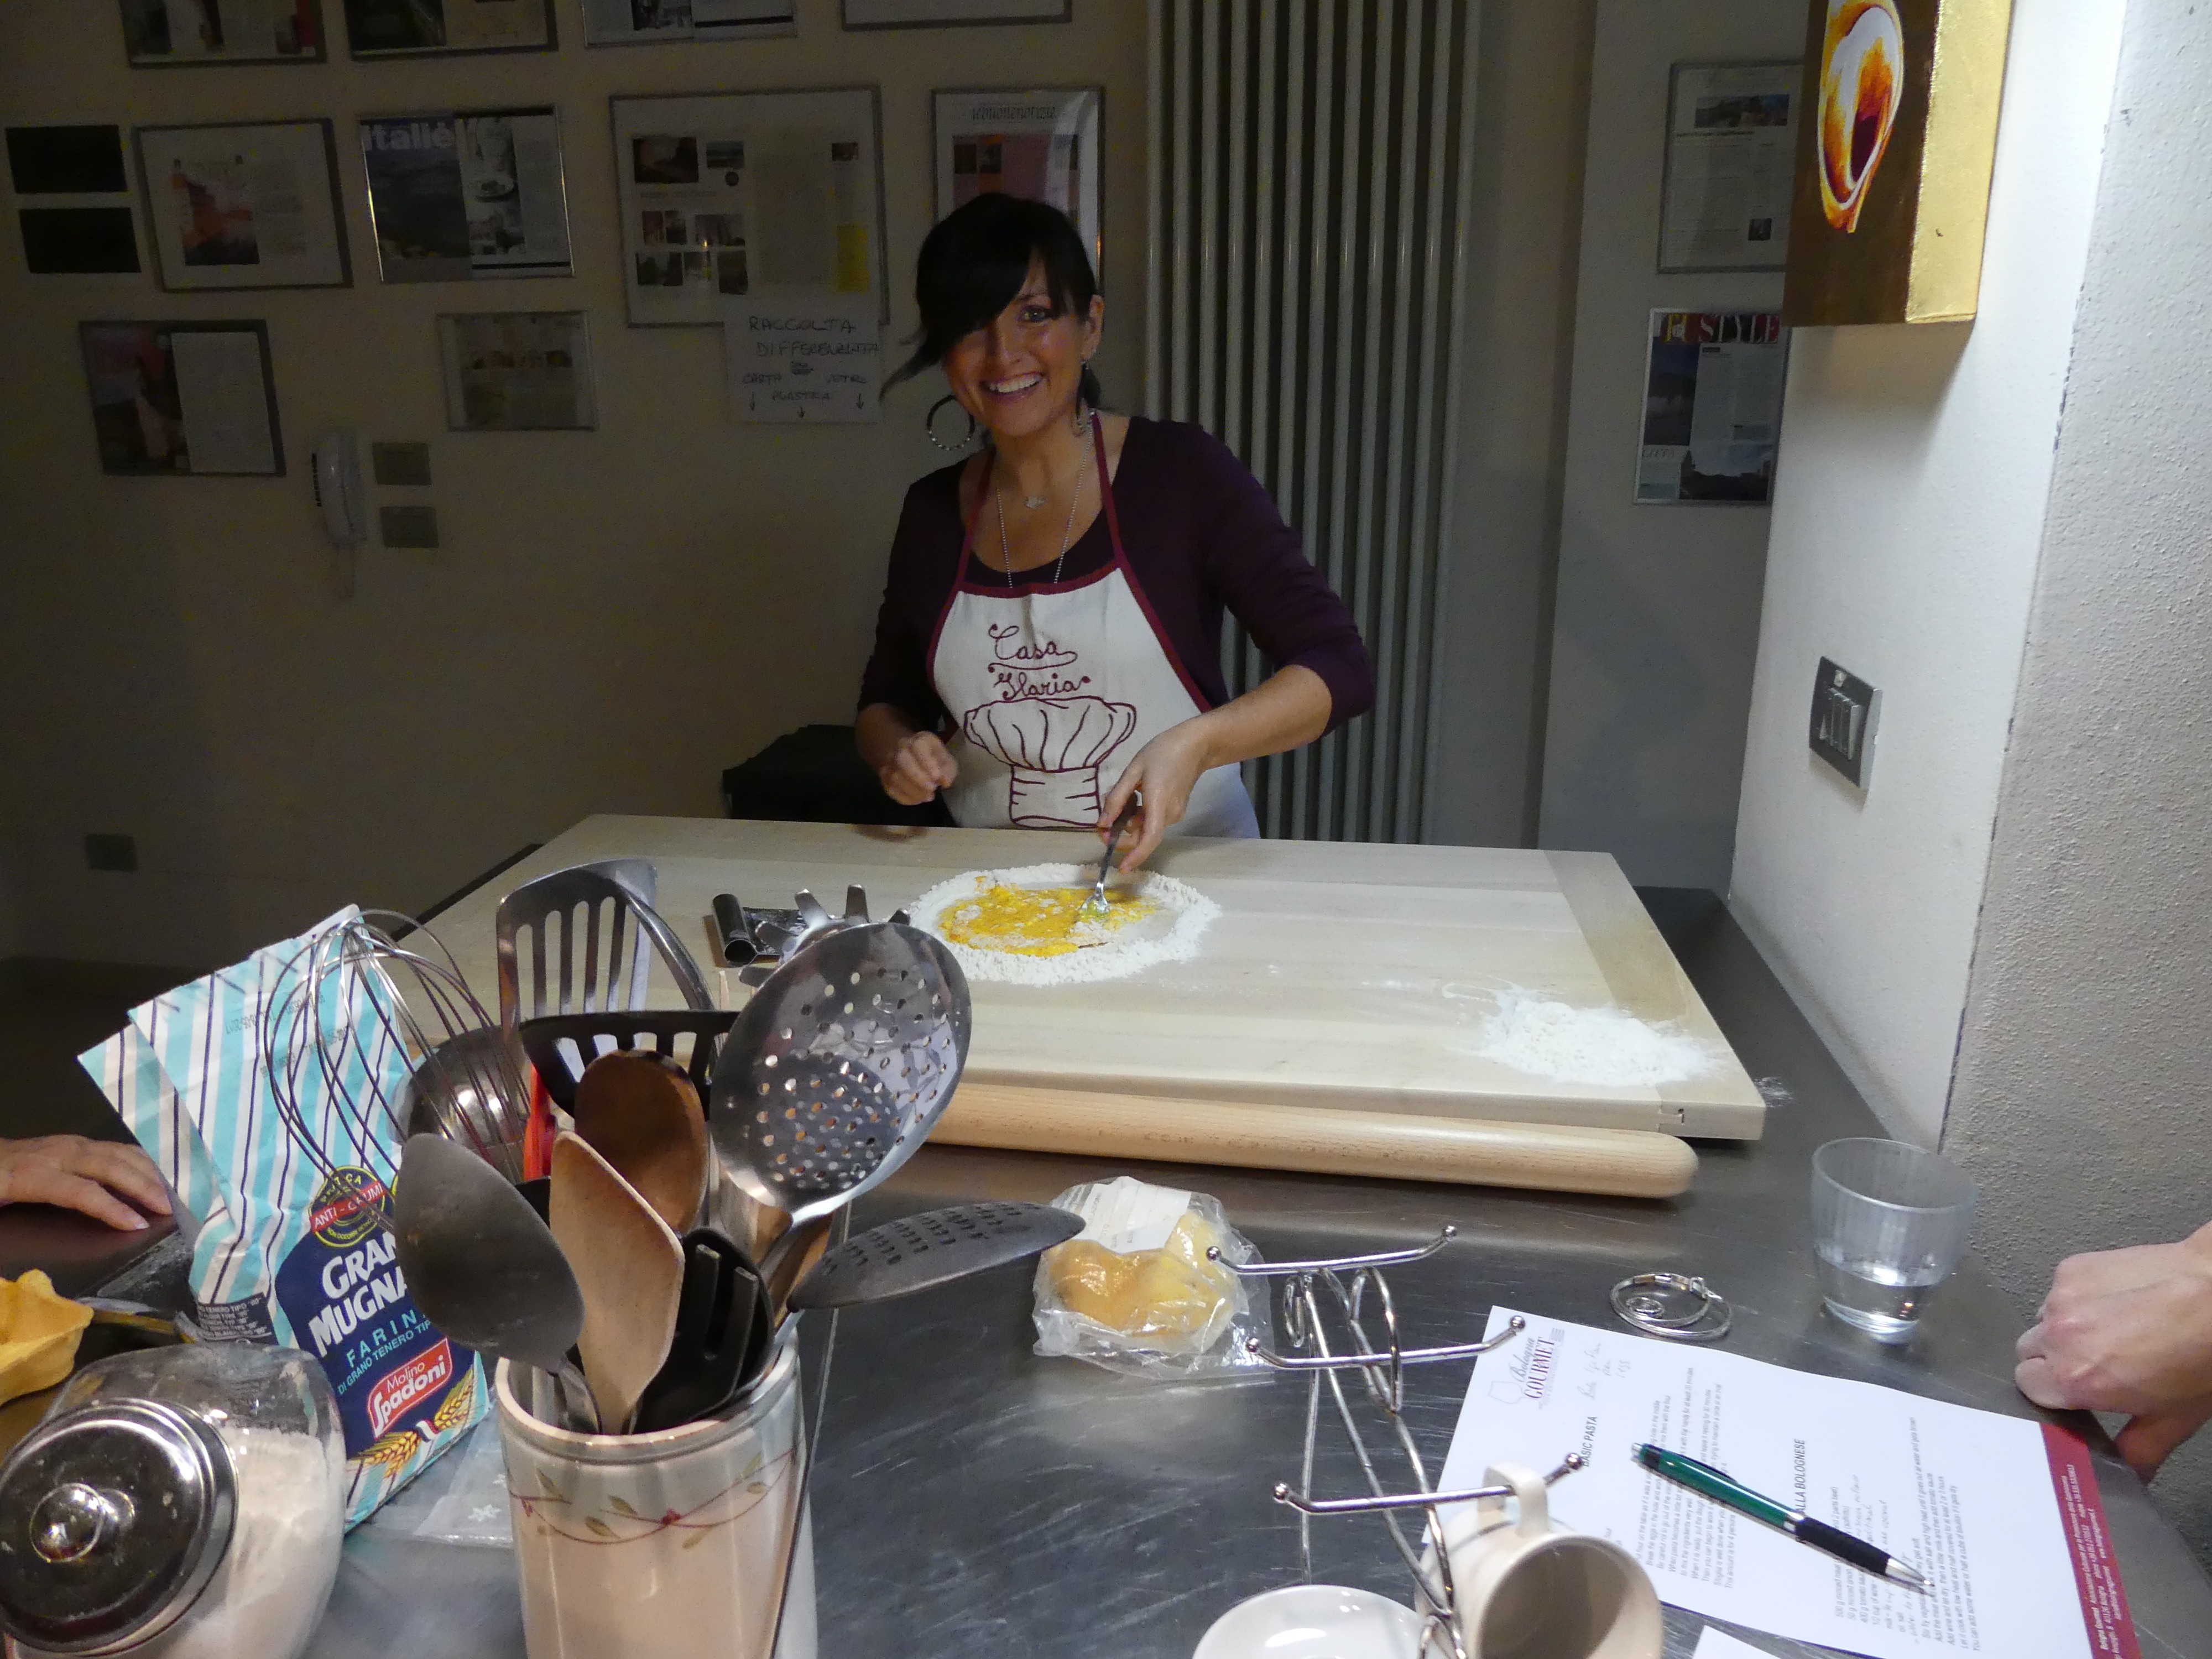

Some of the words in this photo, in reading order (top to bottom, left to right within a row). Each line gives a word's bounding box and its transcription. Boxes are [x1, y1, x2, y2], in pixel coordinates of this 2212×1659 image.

[748, 315, 856, 333] RACCOLTA
[988, 624, 1077, 665] Casa
[314, 1206, 338, 1229] ANTI
[309, 1266, 408, 1358] MUGNA
[346, 1309, 426, 1368] FARIN
[337, 1381, 347, 1395] DI
[346, 1357, 373, 1386] GRANO
[372, 1330, 415, 1361] TENERO
[415, 1318, 431, 1334] TIP
[1508, 1337, 1535, 1383] Bologna
[387, 1361, 425, 1393] Molino
[1524, 1336, 1555, 1400] GOURMET
[374, 1354, 446, 1438] Spadoni
[1583, 1416, 1597, 1442] PASTA
[1582, 1442, 1593, 1468] BASIC
[1793, 1438, 1806, 1490] BOLOGNESE
[1793, 1491, 1806, 1514] ALLA
[1671, 1517, 1680, 1541] becomes
[1921, 1522, 1931, 1534] high
[1923, 1534, 1931, 1546] and
[1945, 1532, 1954, 1554] covered
[1668, 1556, 1676, 1572] When
[1947, 1554, 1956, 1567] half
[1701, 1567, 1710, 1582] Then
[1949, 1566, 1958, 1579] and
[1833, 1578, 1843, 1600] minced
[1859, 1585, 1867, 1606] tomato
[1950, 1579, 1960, 1594] heat
[1835, 1605, 1843, 1618] 500
[1859, 1611, 1867, 1623] 400
[1931, 1603, 1939, 1619] meat
[1942, 1605, 1951, 1618] and
[1934, 1629, 1942, 1642] Add
[1957, 1619, 1965, 1633] cook
[1946, 1632, 1955, 1646] Add
